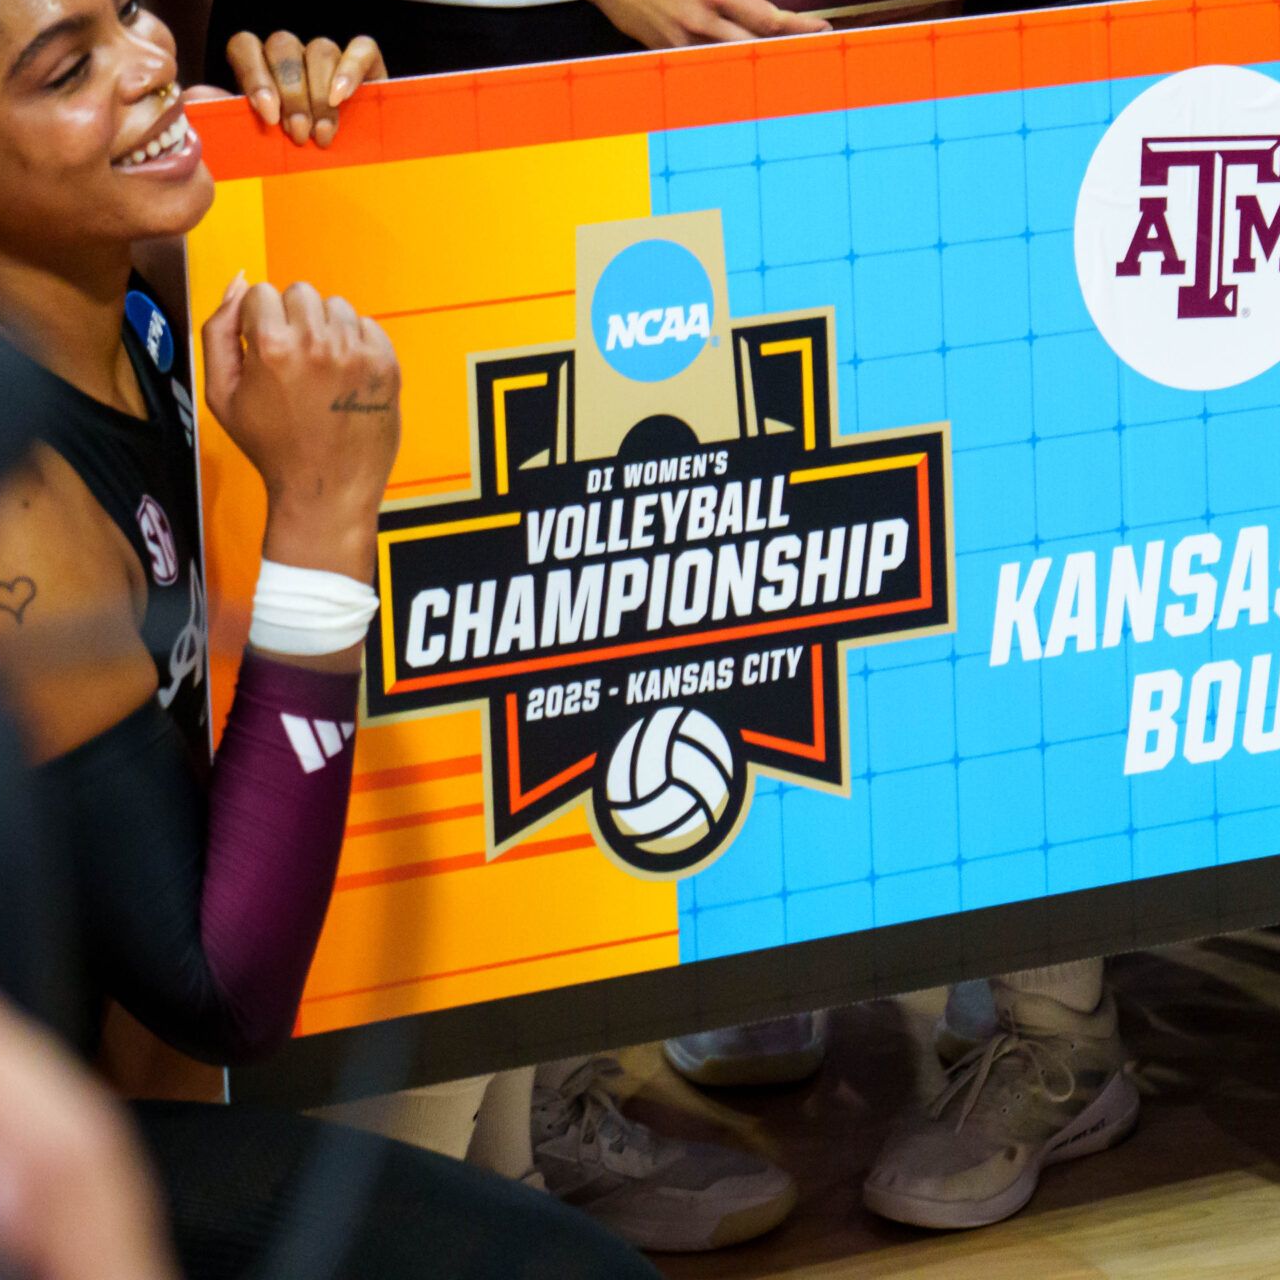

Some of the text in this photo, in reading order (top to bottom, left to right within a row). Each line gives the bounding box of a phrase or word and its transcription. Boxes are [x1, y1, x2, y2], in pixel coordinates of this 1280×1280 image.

[606, 303, 712, 351] NCAA
[585, 450, 729, 495] DI WOMEN'S
[526, 475, 791, 566] VOLLEYBALL
[405, 518, 910, 669] CHAMPIONSHIP
[525, 678, 602, 721] 2025
[626, 657, 735, 706] KANSAS
[741, 645, 805, 687] CITY
